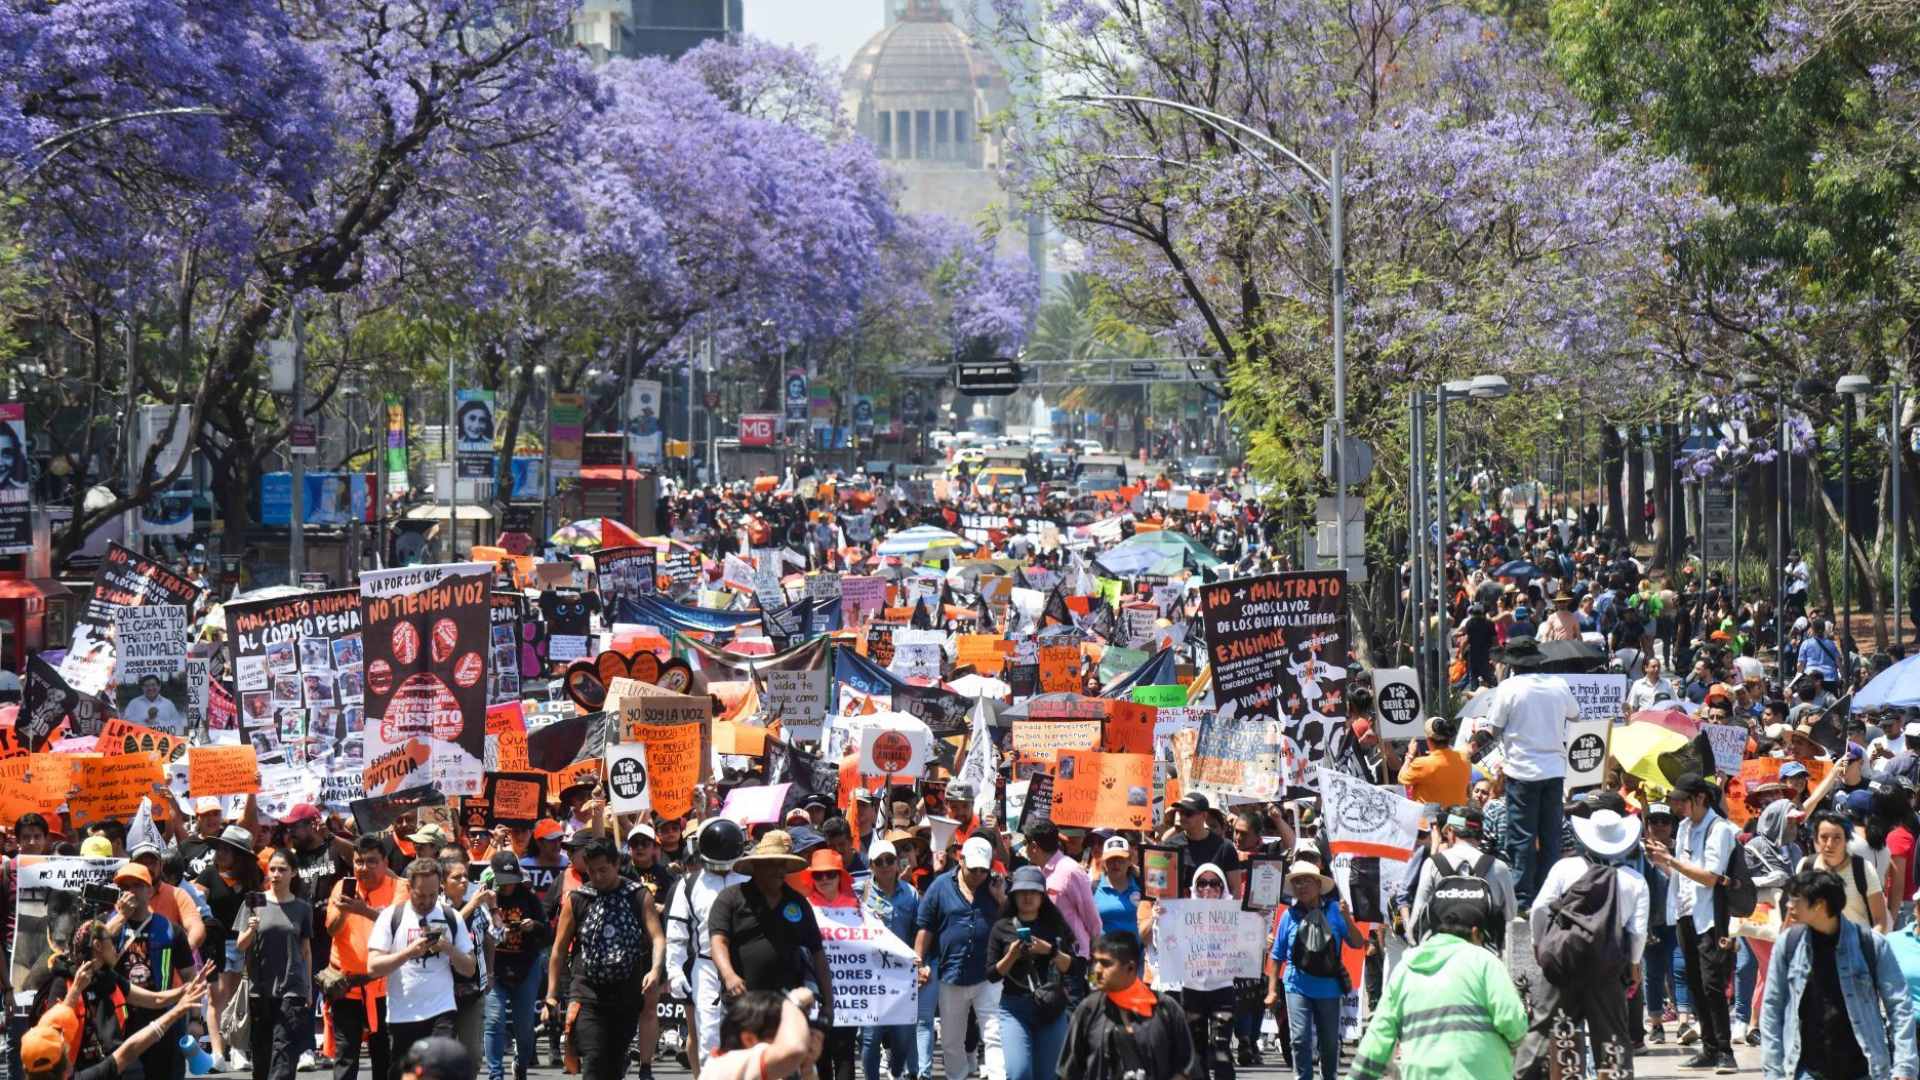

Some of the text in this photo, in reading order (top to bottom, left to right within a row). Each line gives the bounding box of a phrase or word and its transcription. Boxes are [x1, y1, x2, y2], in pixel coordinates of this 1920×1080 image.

[742, 422, 771, 438] MB
[110, 548, 129, 565] NO
[370, 568, 443, 594] VA POR LOS QUE
[1208, 576, 1341, 609] NO + MALTRATO
[368, 580, 483, 625] NO TIENEN VOZ
[1242, 600, 1311, 617] SOMOS LA VOZ
[116, 607, 185, 622] QUE LA VIDA
[237, 592, 361, 633] MALTRATO ANIMAL
[118, 622, 132, 633] TE
[170, 618, 184, 629] TU
[1217, 612, 1336, 634] DE LOS QUE NO LA TIENEN
[153, 632, 162, 642] A
[238, 633, 259, 654] AL
[316, 610, 363, 636] PENA
[126, 642, 187, 657] ANIMALES
[1216, 628, 1287, 664] EXIGIMOS
[774, 680, 813, 691] vida te
[795, 694, 818, 704] como
[1403, 698, 1416, 709] SU
[681, 708, 705, 721] VOZ
[784, 715, 822, 727] animales
[1392, 710, 1412, 721] VOZ
[1590, 748, 1601, 758] SU
[1578, 758, 1596, 770] VOZ
[368, 757, 418, 791] JUSTICIA
[630, 772, 642, 784] SU
[620, 784, 639, 796] VOZ
[40, 870, 53, 880] NO
[57, 870, 67, 879] AL
[1435, 888, 1485, 899] adidas
[1185, 912, 1204, 926] QUE
